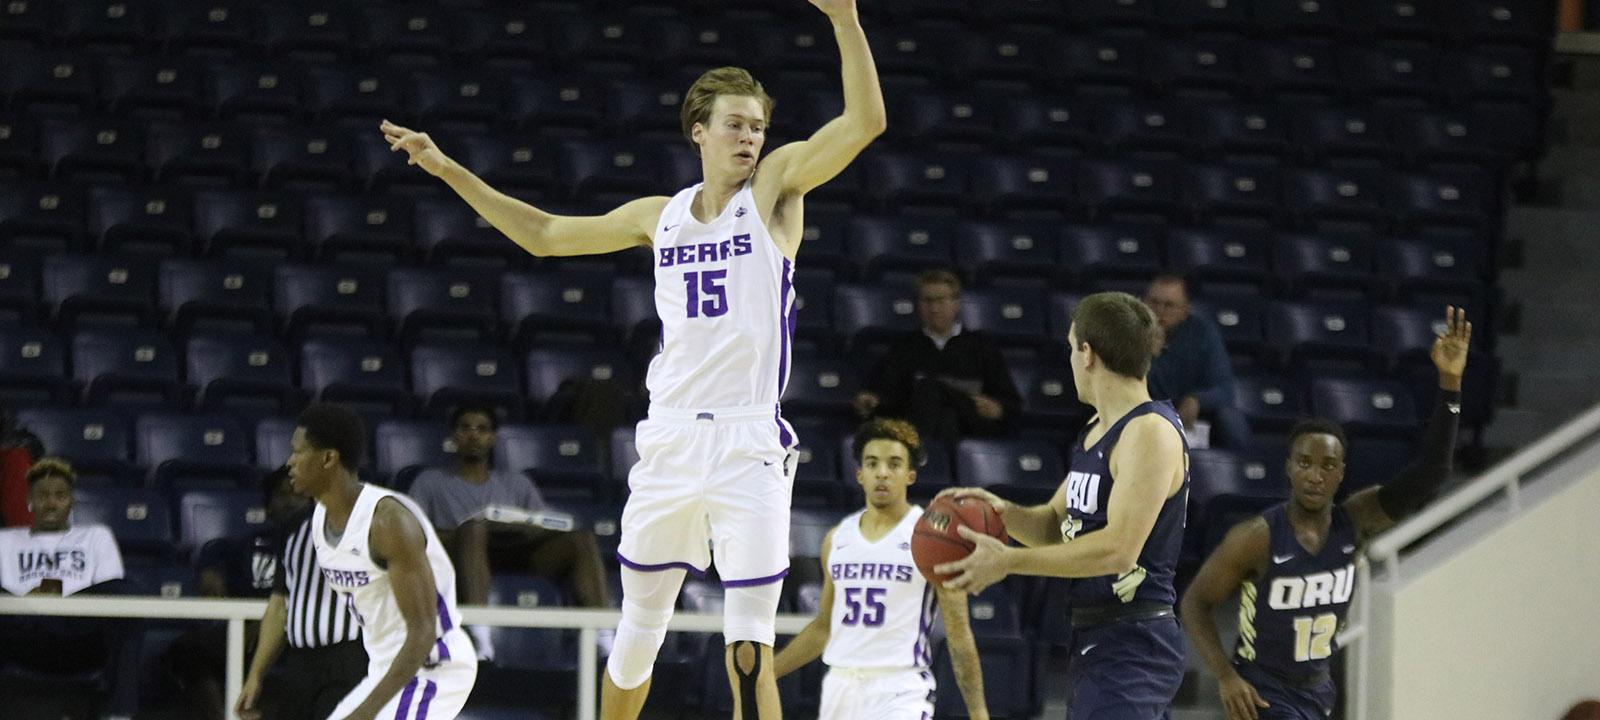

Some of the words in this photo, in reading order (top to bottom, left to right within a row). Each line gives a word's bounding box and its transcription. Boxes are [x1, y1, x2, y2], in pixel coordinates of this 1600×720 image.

[659, 233, 752, 267] BEARS
[683, 269, 729, 318] 15
[1066, 471, 1101, 515] RU
[18, 550, 86, 572] UAFS
[322, 567, 370, 588] EARS
[831, 563, 913, 583] BEARS
[842, 587, 887, 628] 55
[1268, 564, 1355, 610] ORU
[1293, 614, 1337, 662] 12
